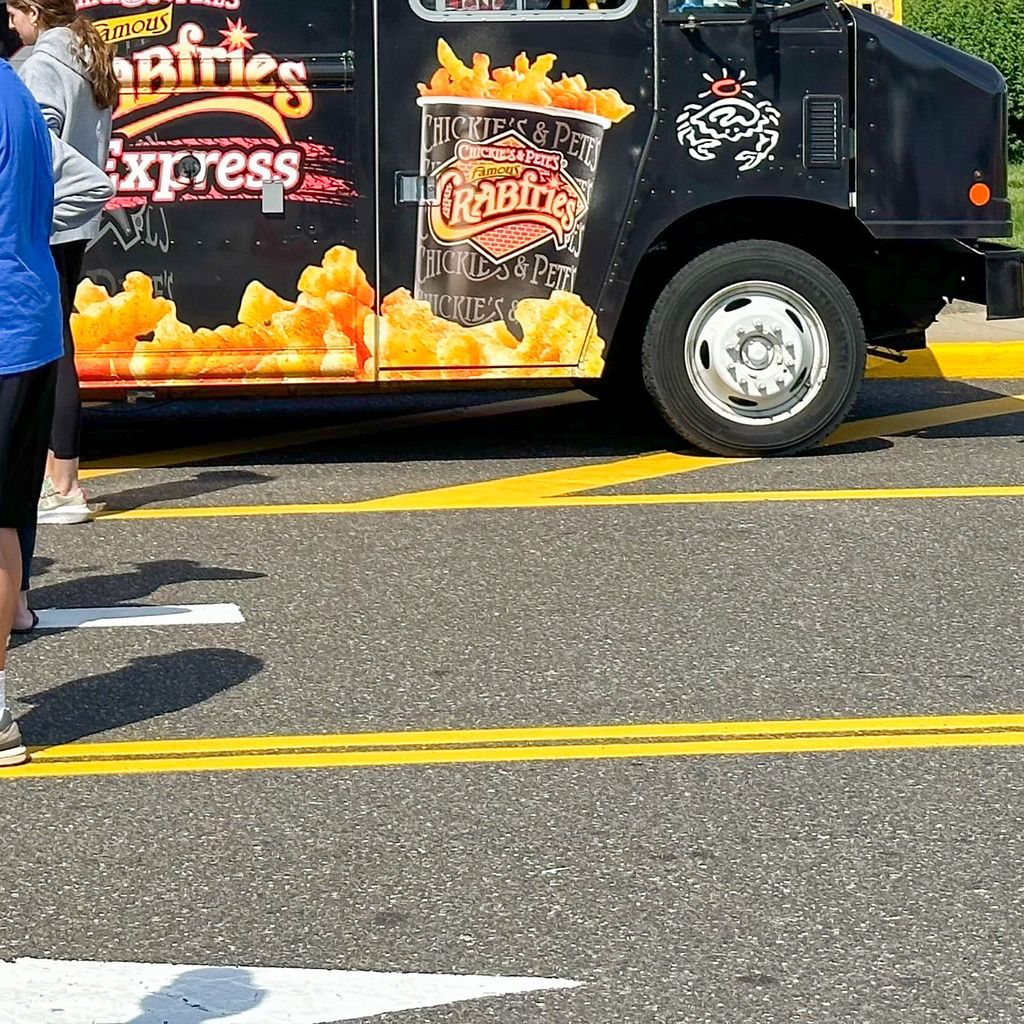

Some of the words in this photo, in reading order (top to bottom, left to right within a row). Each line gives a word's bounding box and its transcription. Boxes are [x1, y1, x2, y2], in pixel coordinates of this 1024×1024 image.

[94, 13, 170, 41] amous
[532, 121, 550, 147] &
[514, 255, 529, 280] &
